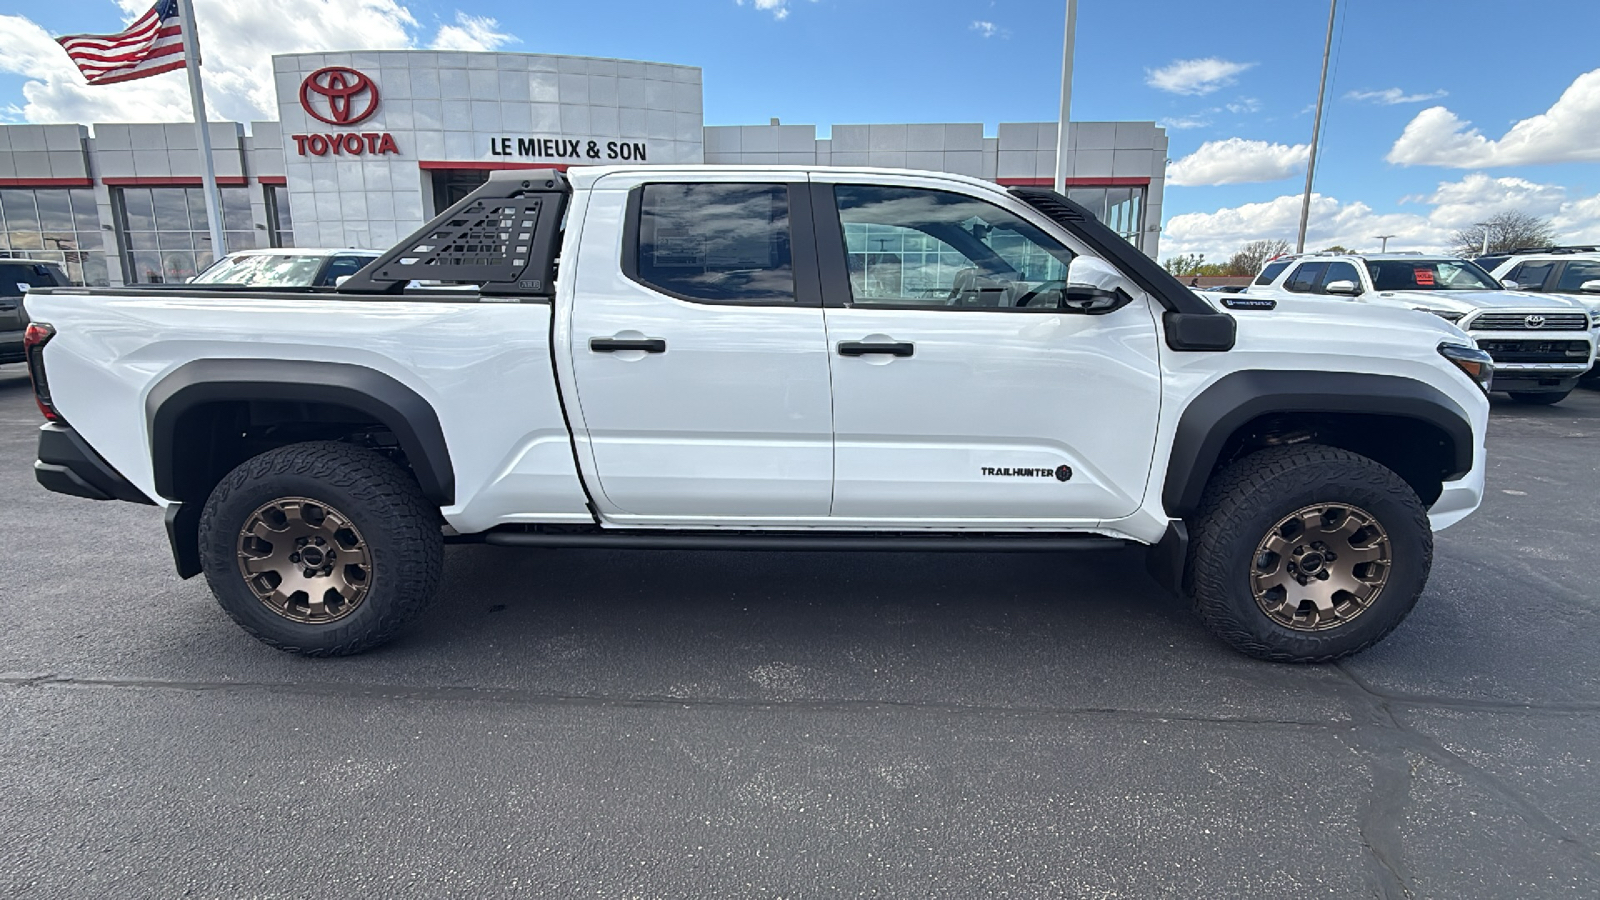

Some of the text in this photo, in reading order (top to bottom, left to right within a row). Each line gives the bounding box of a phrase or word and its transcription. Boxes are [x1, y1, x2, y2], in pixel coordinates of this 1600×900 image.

[292, 133, 399, 156] TOYOTA
[491, 138, 647, 161] LE MIEUX & SON
[981, 467, 1054, 478] TRAILHUNTER
